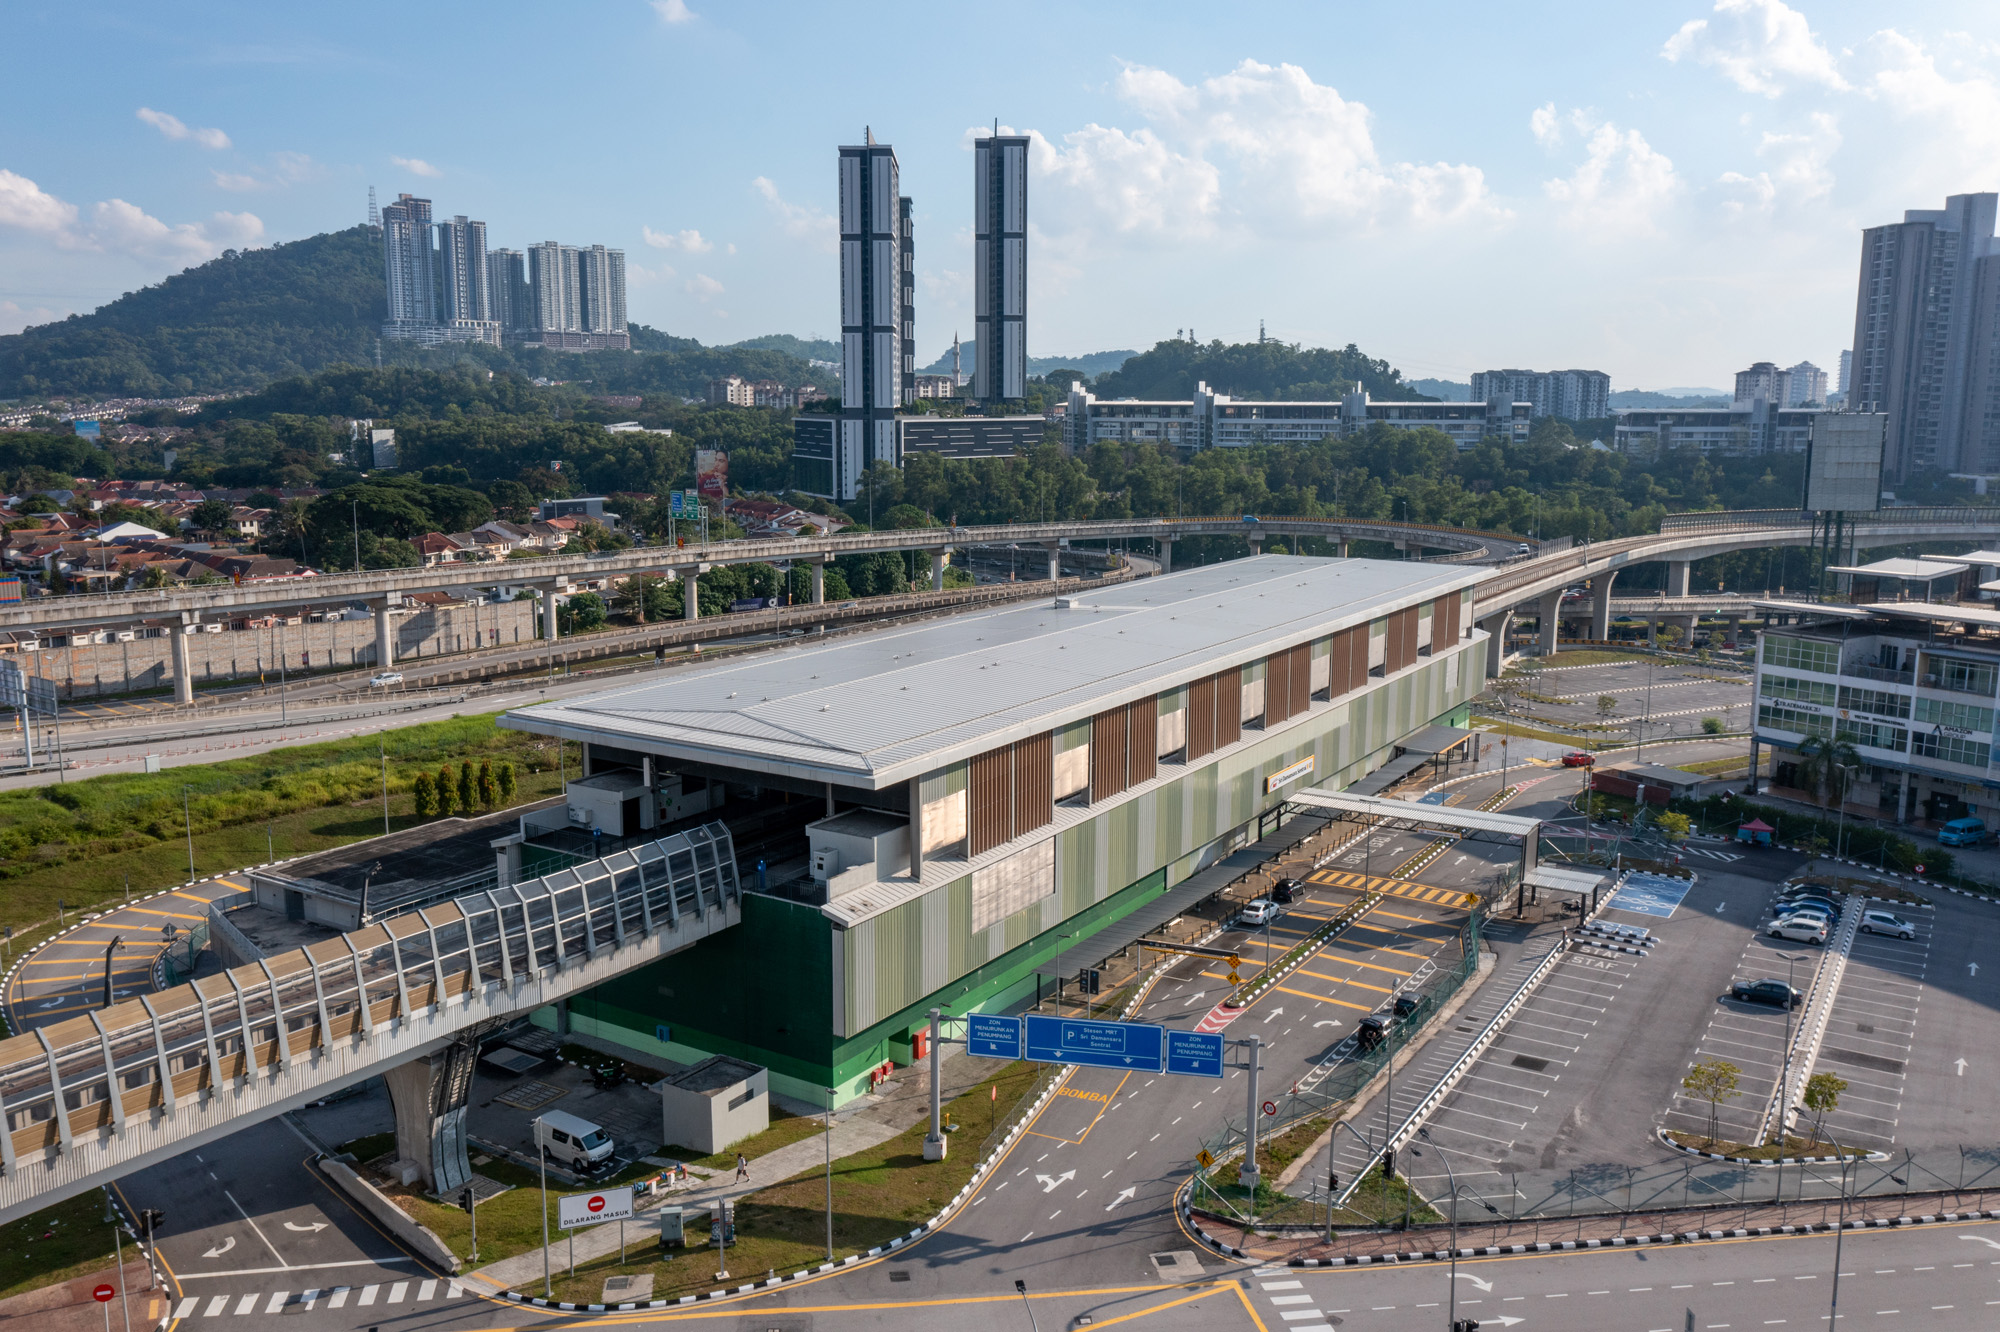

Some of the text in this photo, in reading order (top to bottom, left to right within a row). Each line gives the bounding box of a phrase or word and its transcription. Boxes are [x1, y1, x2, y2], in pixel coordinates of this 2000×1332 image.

[1943, 731, 1966, 739] GROUP
[1944, 726, 1973, 735] AMAZON
[1580, 946, 1626, 959] STAF
[1571, 956, 1619, 969] STAF
[975, 1025, 1014, 1033] MENURUNKAN
[977, 1031, 1012, 1040] PENUMPANG
[1067, 1031, 1075, 1040] P
[1090, 1035, 1122, 1043] Damansara
[1174, 1042, 1216, 1050] MENURUNKAN
[1176, 1049, 1213, 1057] PENUMPANG
[1058, 1087, 1108, 1103] BOMBA
[564, 1210, 629, 1225] DILARANG MASUK
